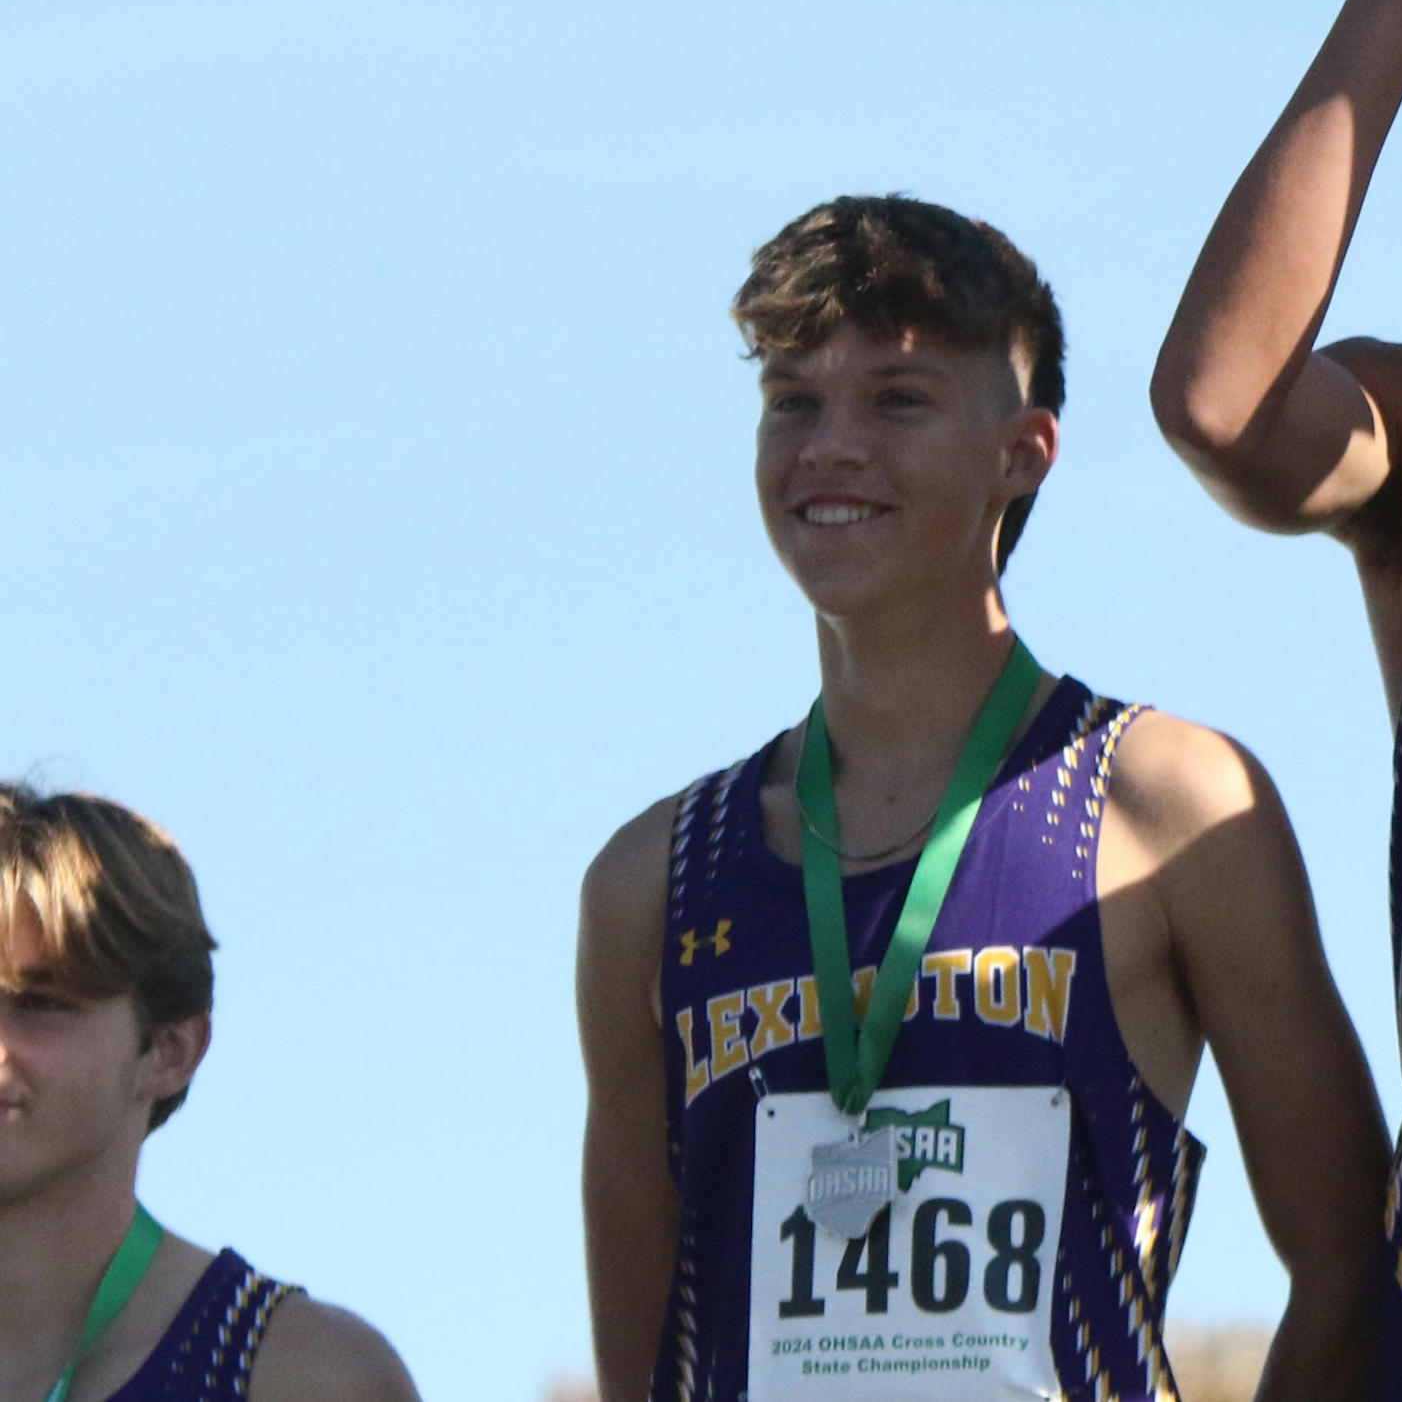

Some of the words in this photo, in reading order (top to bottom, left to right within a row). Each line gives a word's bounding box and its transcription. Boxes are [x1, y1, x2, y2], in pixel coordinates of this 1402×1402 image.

[777, 1197, 1047, 1319] 1468
[772, 1338, 812, 1355] 2024
[818, 1335, 884, 1352] OHSAA
[892, 1334, 945, 1349] Cross
[952, 1332, 1029, 1351] Country
[802, 1358, 850, 1374] State
[857, 1354, 991, 1374] Championship
